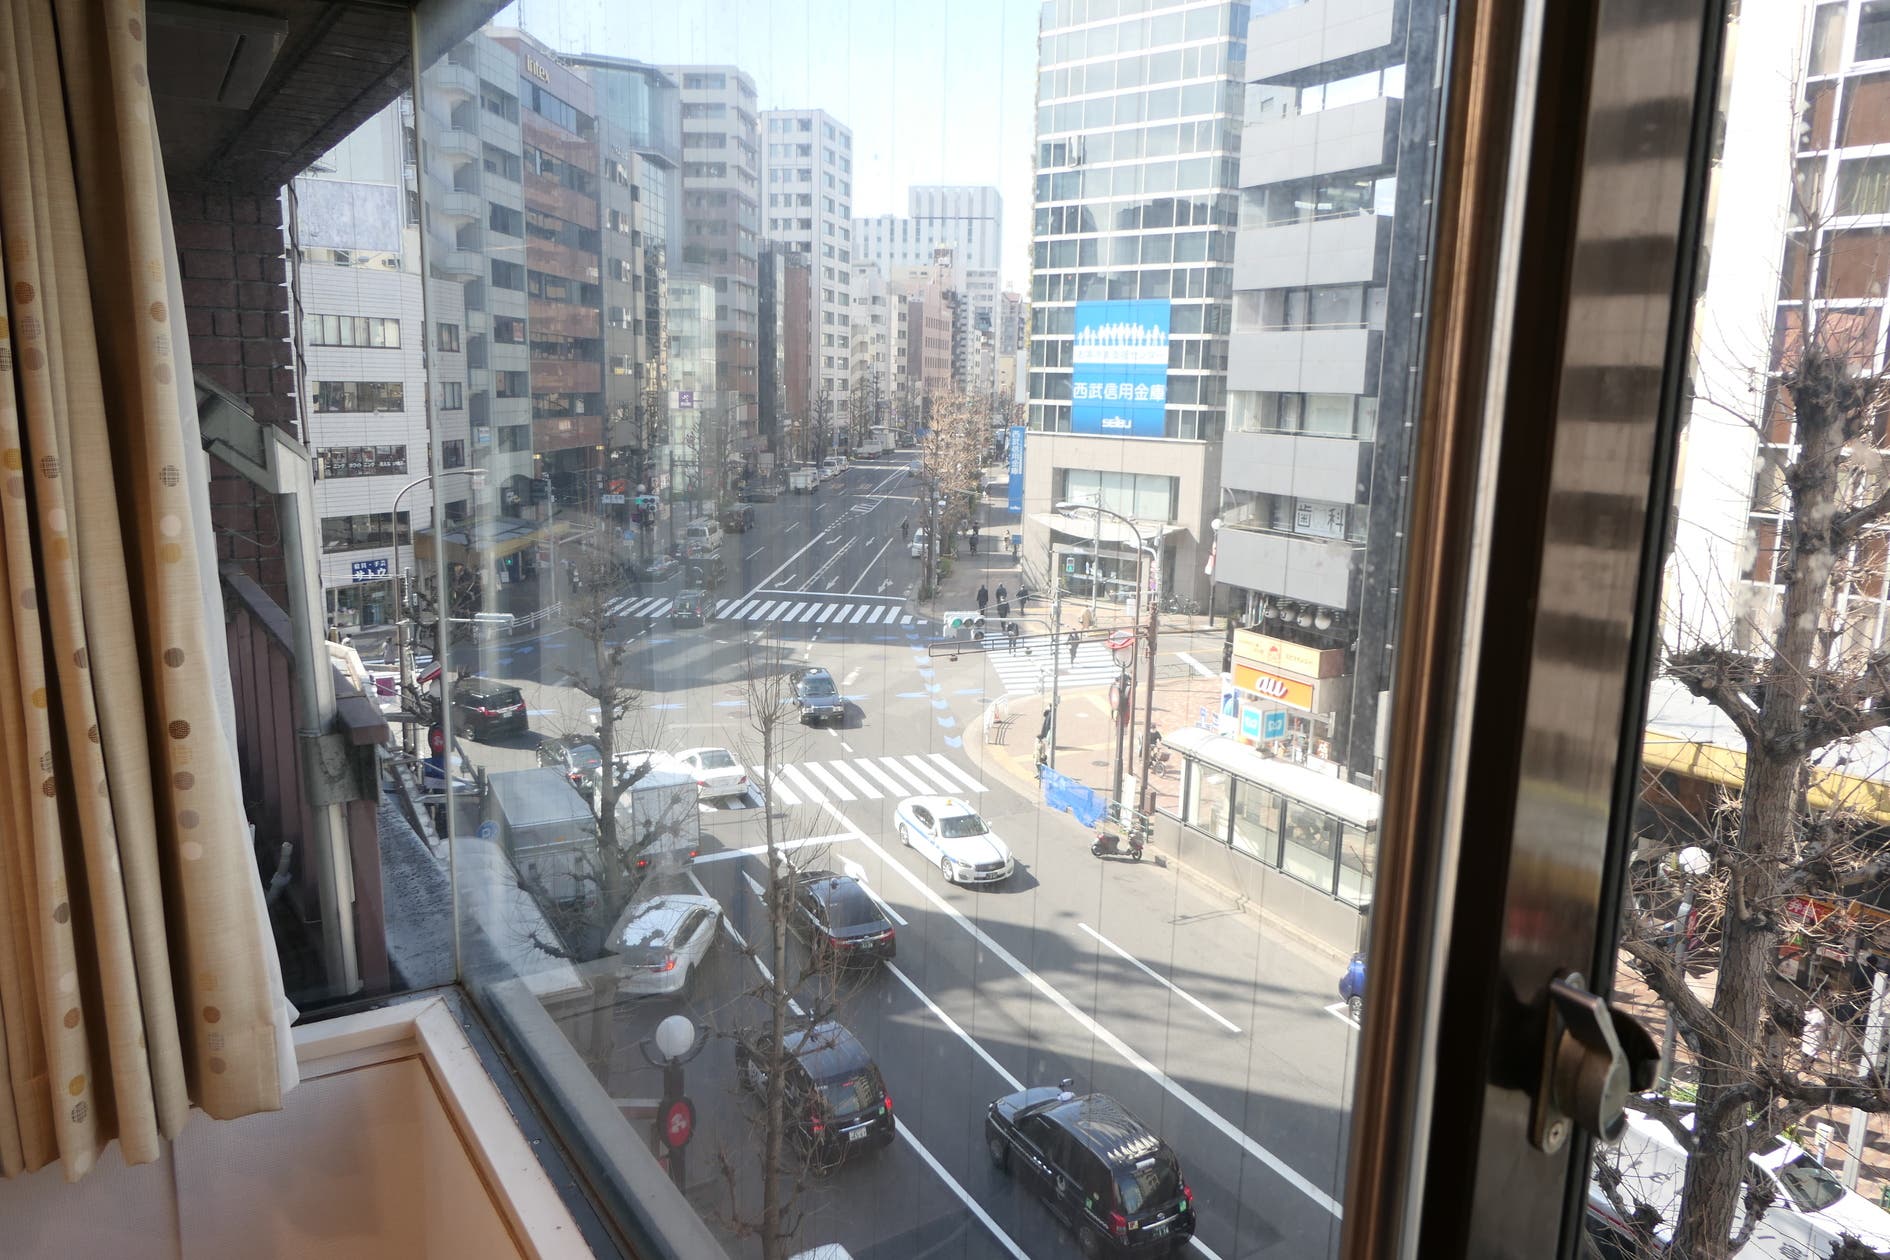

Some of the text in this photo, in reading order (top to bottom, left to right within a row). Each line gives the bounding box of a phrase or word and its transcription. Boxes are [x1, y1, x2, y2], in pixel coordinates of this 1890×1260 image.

[1073, 382, 1167, 402] 西武信用金庫
[1256, 674, 1288, 699] au
